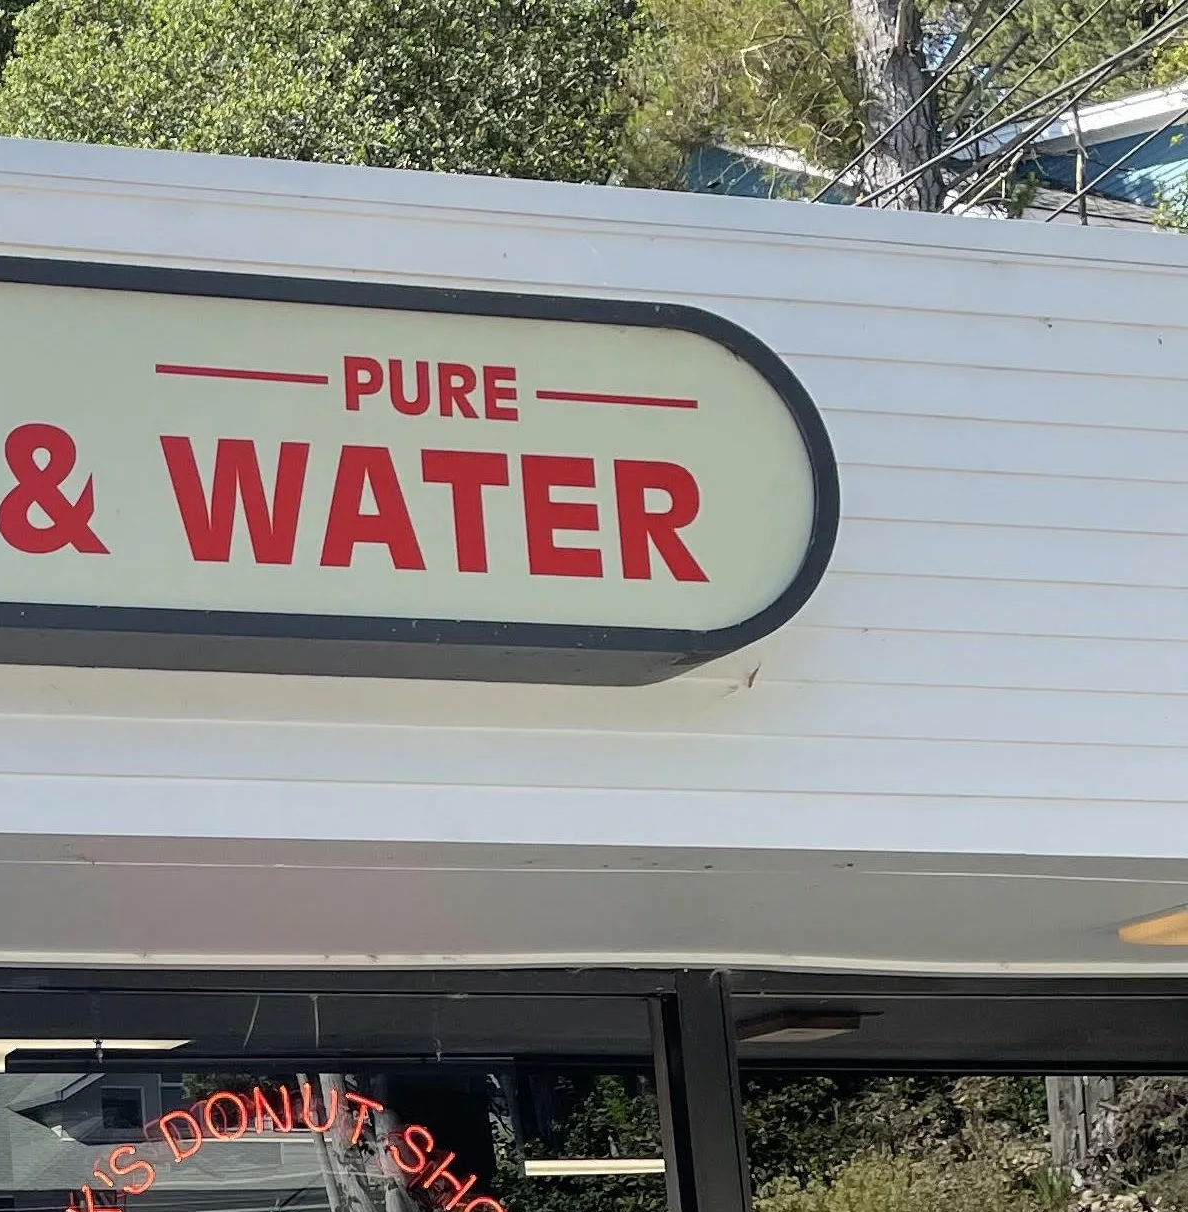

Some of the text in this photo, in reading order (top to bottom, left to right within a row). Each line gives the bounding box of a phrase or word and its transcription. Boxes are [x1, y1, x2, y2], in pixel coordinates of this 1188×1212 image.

[343, 355, 519, 421] PURE
[159, 435, 710, 583] WATER
[159, 1083, 384, 1163] DONUT
